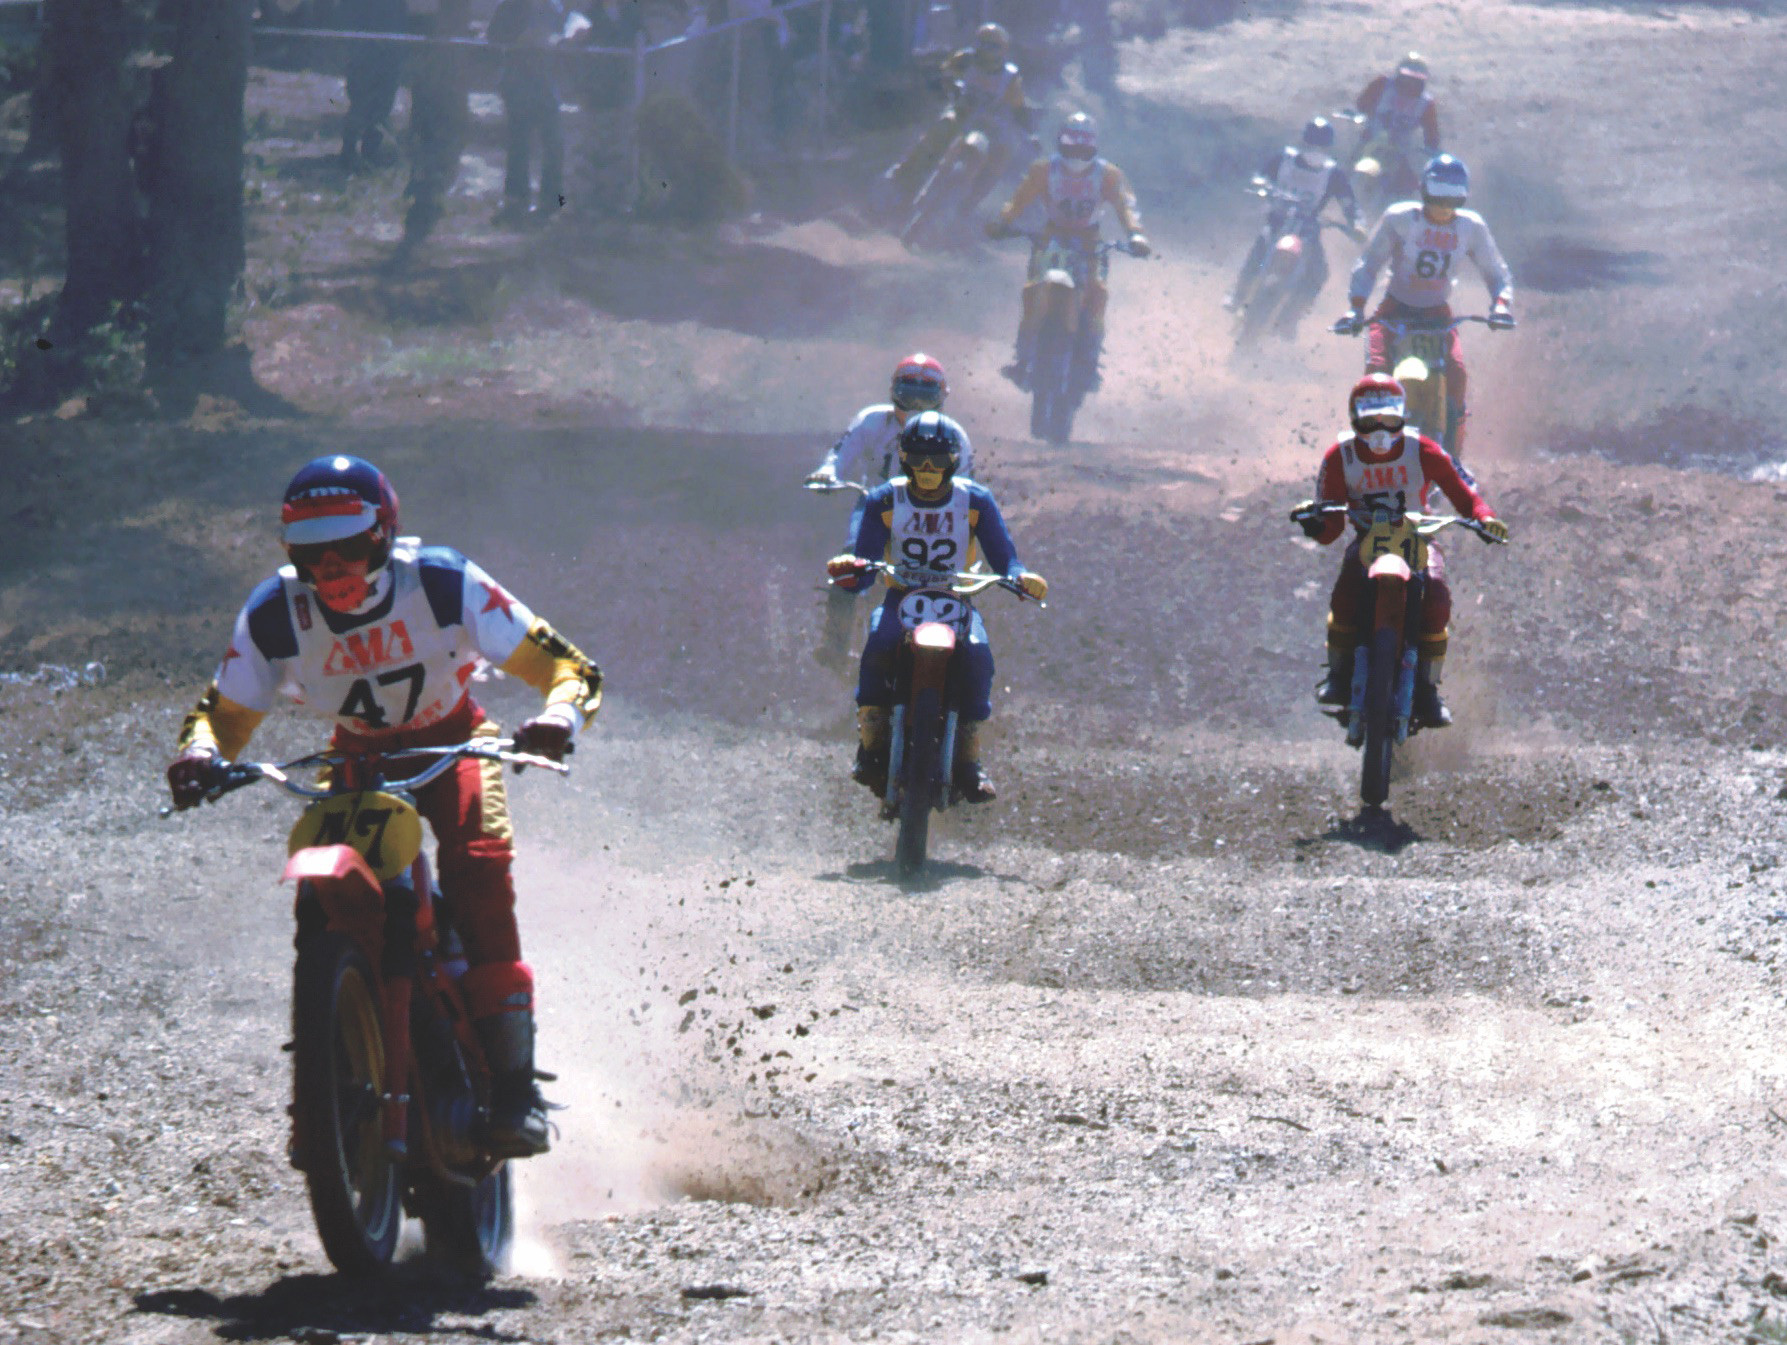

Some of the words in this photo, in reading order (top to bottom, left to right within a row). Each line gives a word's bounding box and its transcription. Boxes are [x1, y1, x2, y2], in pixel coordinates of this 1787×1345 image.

[1416, 250, 1451, 279] 61
[1362, 491, 1406, 515] 51
[903, 511, 954, 534] AMA
[902, 538, 957, 571] 92
[1371, 536, 1411, 567] 51
[323, 619, 414, 676] AMA
[338, 662, 426, 728] 47
